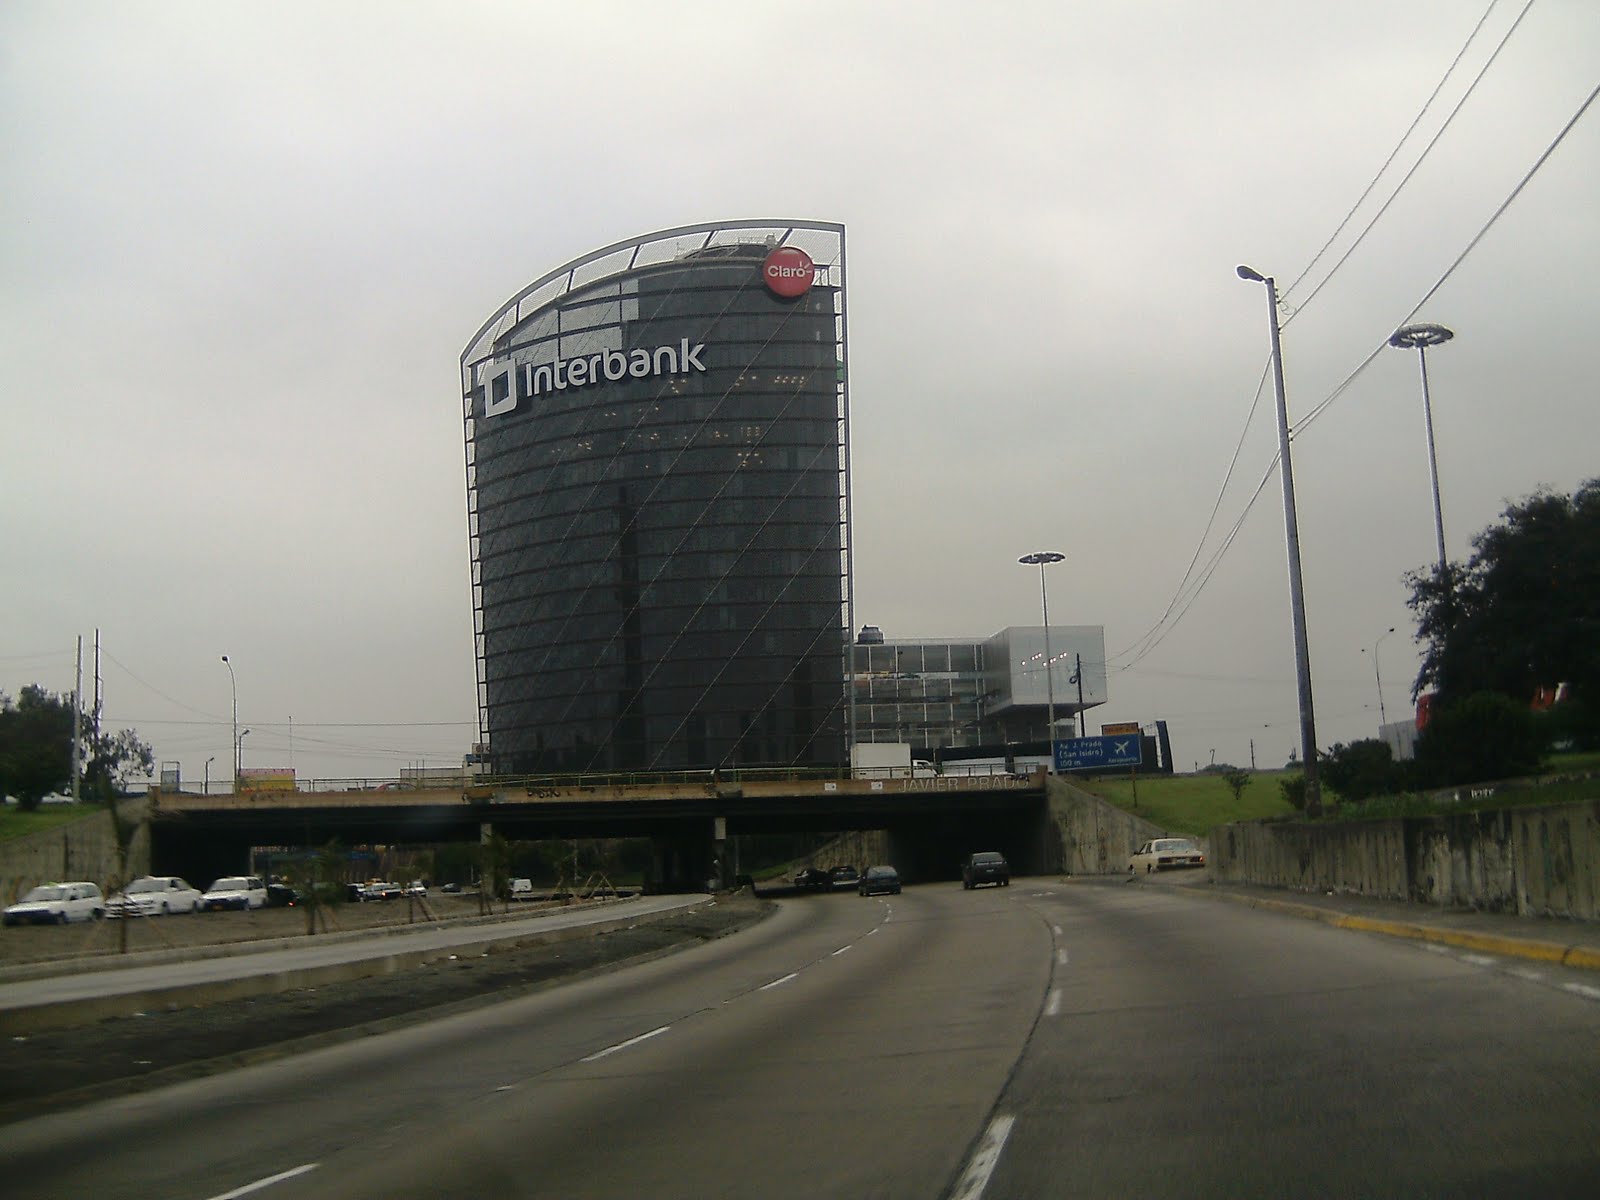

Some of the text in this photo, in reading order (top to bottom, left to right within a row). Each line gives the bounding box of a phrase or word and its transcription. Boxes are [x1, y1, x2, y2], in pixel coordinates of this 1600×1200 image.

[767, 265, 806, 277] Claro
[526, 338, 707, 397] Interbank
[1080, 740, 1102, 748] Prado
[899, 774, 1029, 793] JAVIER PRADO
